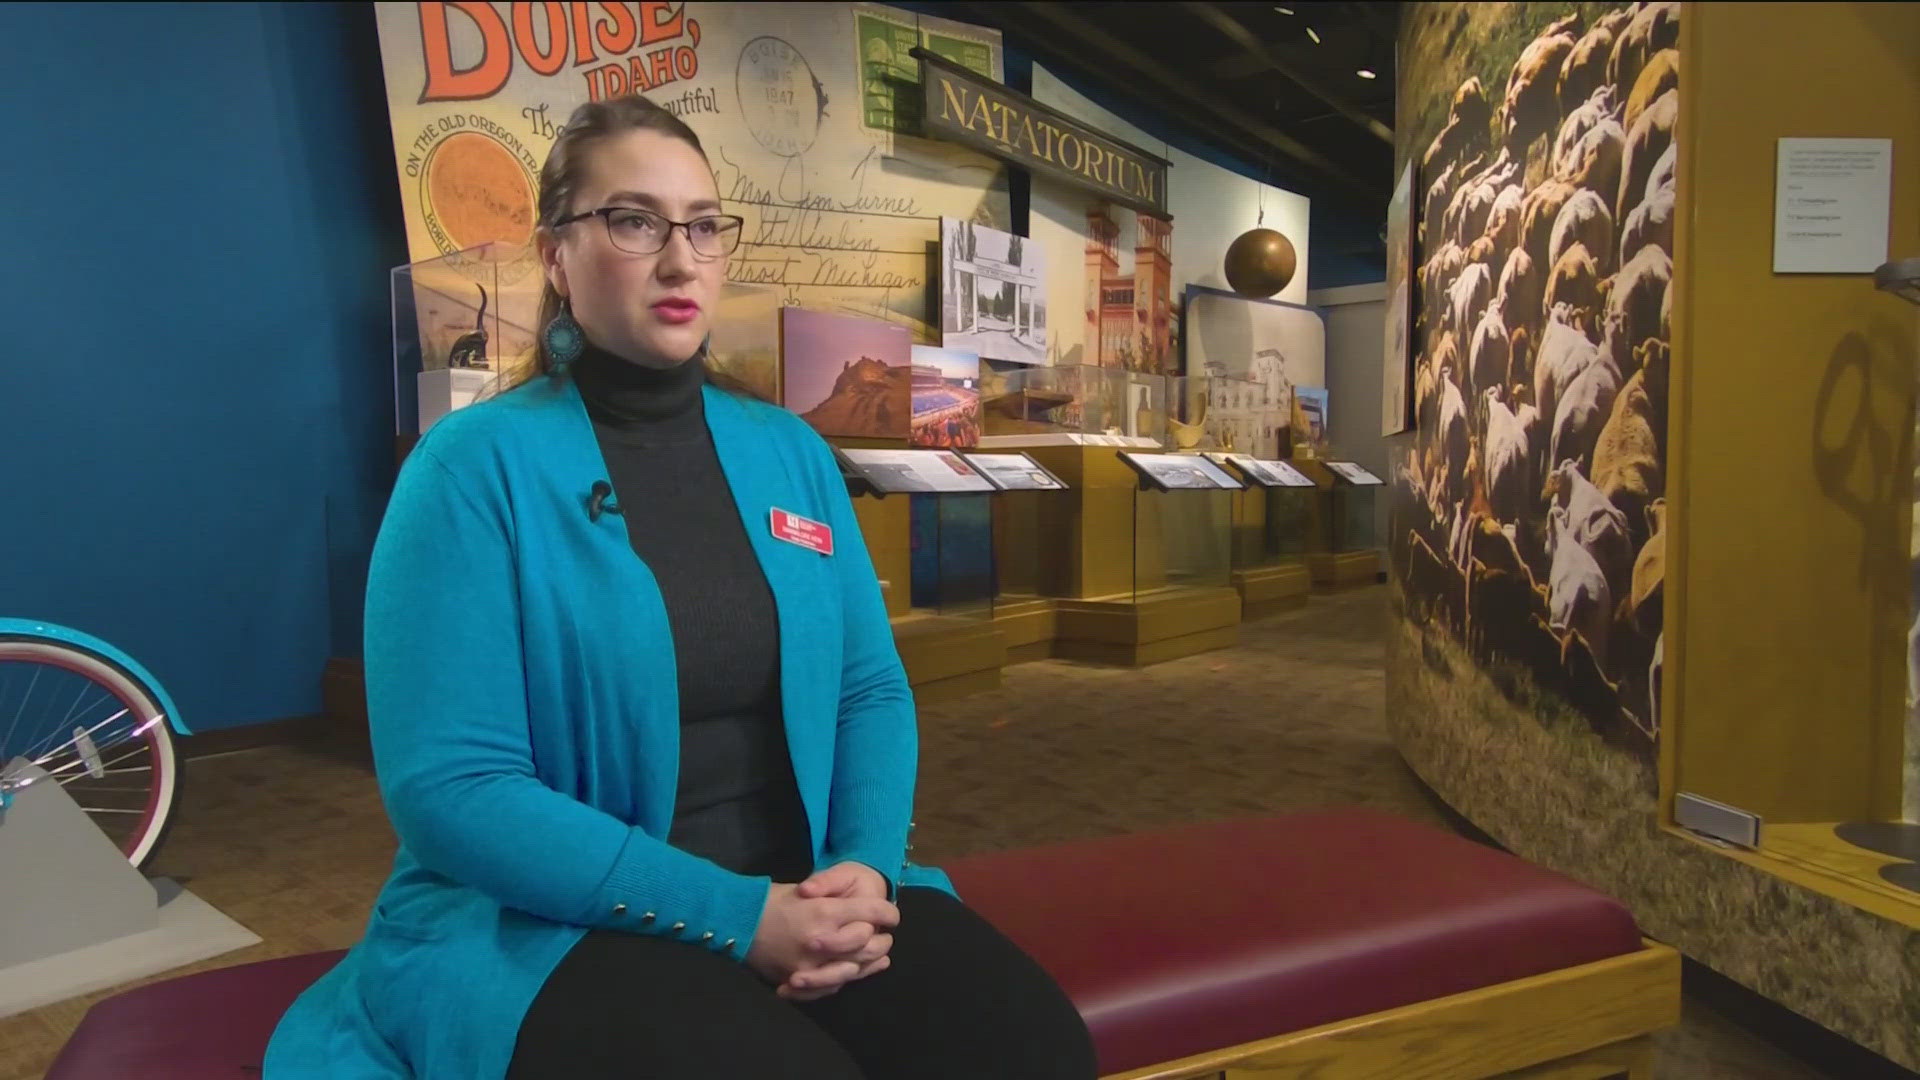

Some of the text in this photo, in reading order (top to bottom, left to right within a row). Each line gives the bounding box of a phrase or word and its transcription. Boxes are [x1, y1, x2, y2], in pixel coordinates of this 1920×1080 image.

[583, 44, 699, 105] IDAHO
[663, 87, 720, 116] autiful
[413, 123, 440, 151] THE
[437, 114, 466, 132] OLD
[469, 114, 523, 153] OREGON
[940, 78, 1156, 203] NATATORIUM
[405, 153, 422, 178] ON
